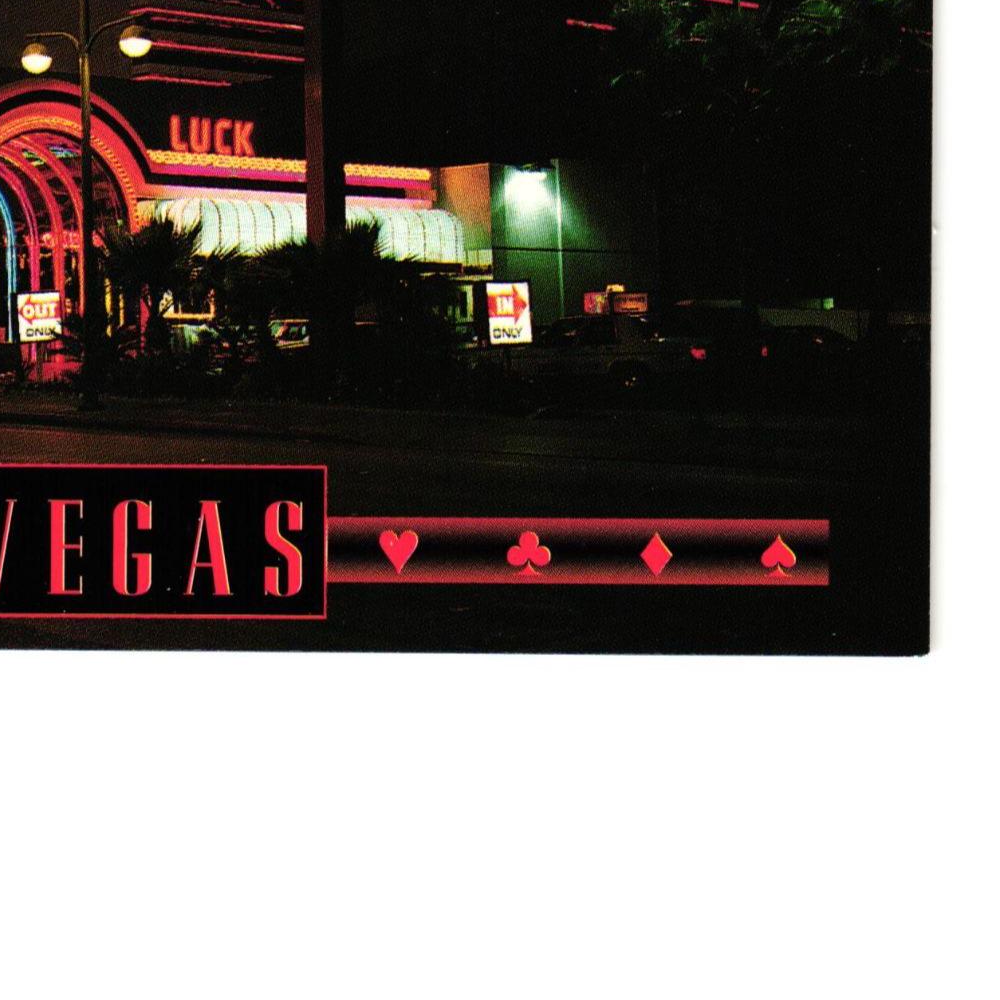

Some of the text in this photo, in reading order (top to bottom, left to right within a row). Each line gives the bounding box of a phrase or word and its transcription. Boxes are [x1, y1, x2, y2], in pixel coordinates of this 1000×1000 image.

[169, 115, 255, 156] LUCK
[22, 302, 58, 319] OUT
[496, 295, 514, 315] IN
[26, 327, 57, 338] ONLY
[493, 327, 523, 339] ONLY
